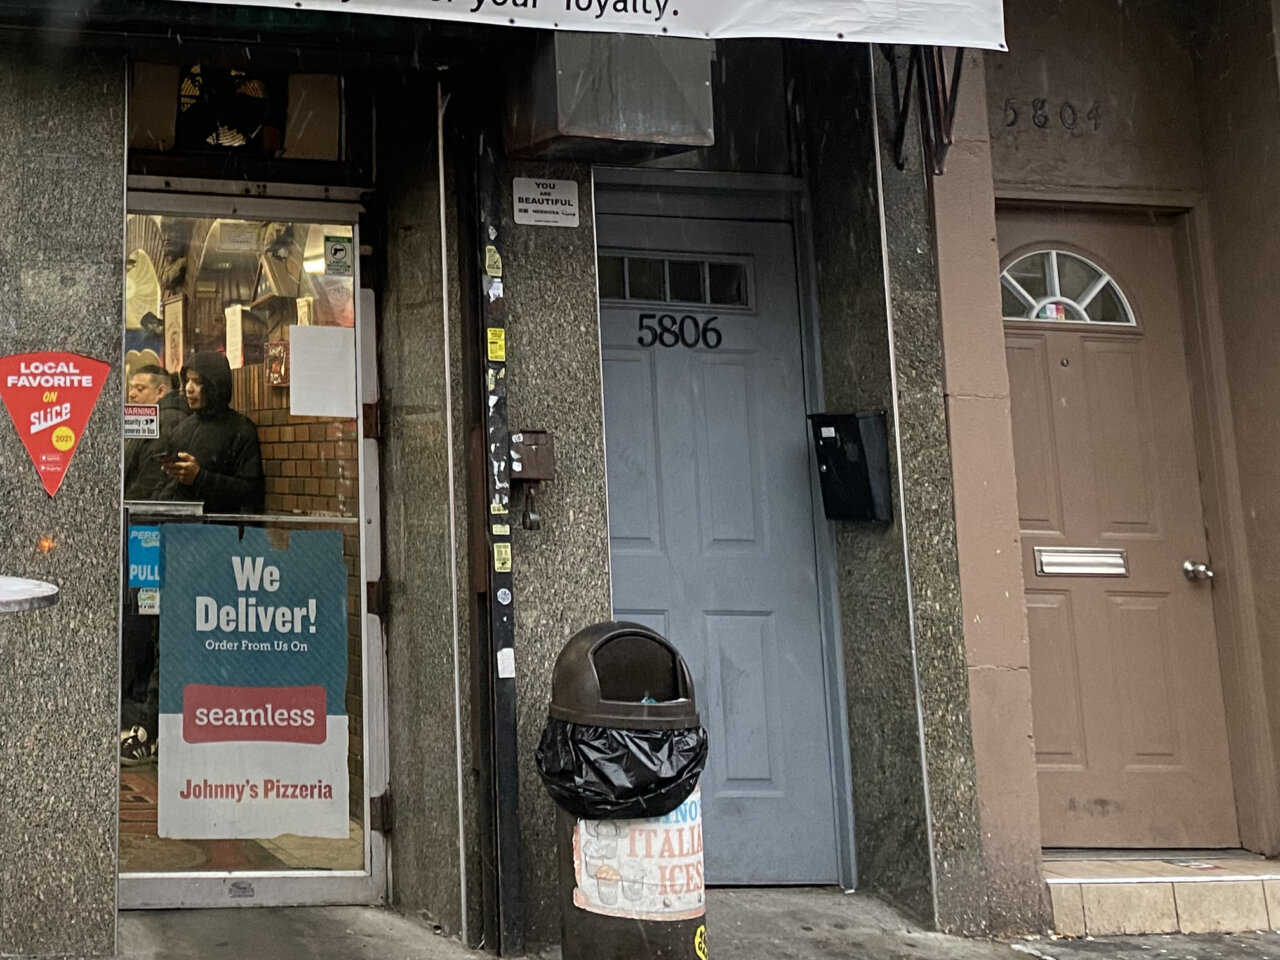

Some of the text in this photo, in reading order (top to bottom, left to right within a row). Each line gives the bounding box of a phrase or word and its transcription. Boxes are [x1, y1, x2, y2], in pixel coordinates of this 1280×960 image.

[534, 181, 556, 190] YOU
[517, 196, 574, 207] BEAUTIFUL
[637, 313, 723, 350] 5806
[20, 361, 80, 374] LOCAL
[6, 375, 93, 388] FAVORITE
[42, 391, 58, 403] ON
[55, 435, 73, 443] 2021
[129, 564, 161, 581] PULL
[231, 555, 281, 592] We
[195, 596, 317, 634] Deliver!
[205, 639, 308, 652] Order From Us On
[194, 703, 316, 728] seamless
[179, 779, 334, 804] Johnny's Pizzeria
[657, 860, 705, 896] ICES
